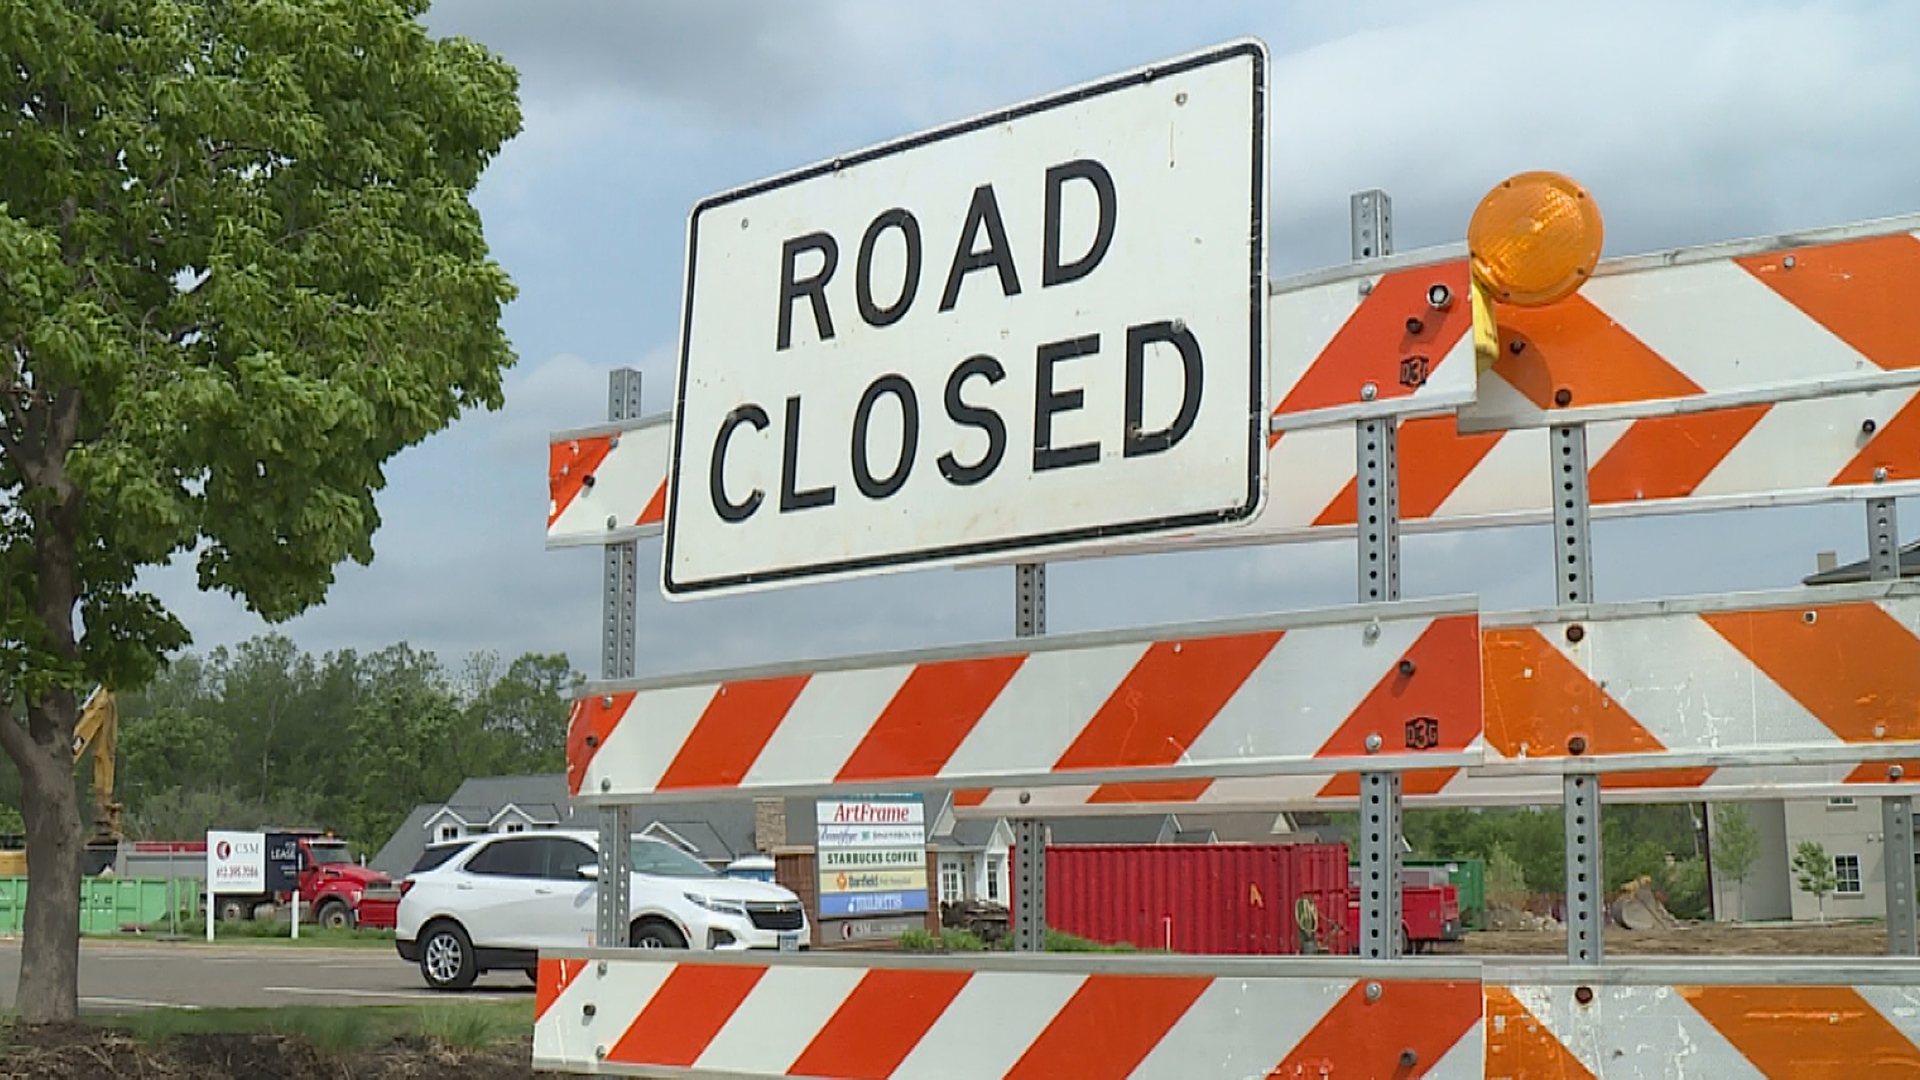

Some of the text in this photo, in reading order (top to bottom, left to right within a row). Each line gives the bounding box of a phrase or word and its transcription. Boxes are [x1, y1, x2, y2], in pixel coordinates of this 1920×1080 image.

[776, 158, 1118, 352] ROAD
[709, 320, 1204, 525] CLOSED
[833, 802, 910, 822] ArtFrame
[235, 843, 259, 854] CSM
[827, 851, 918, 864] STARBUCKS COFFEE
